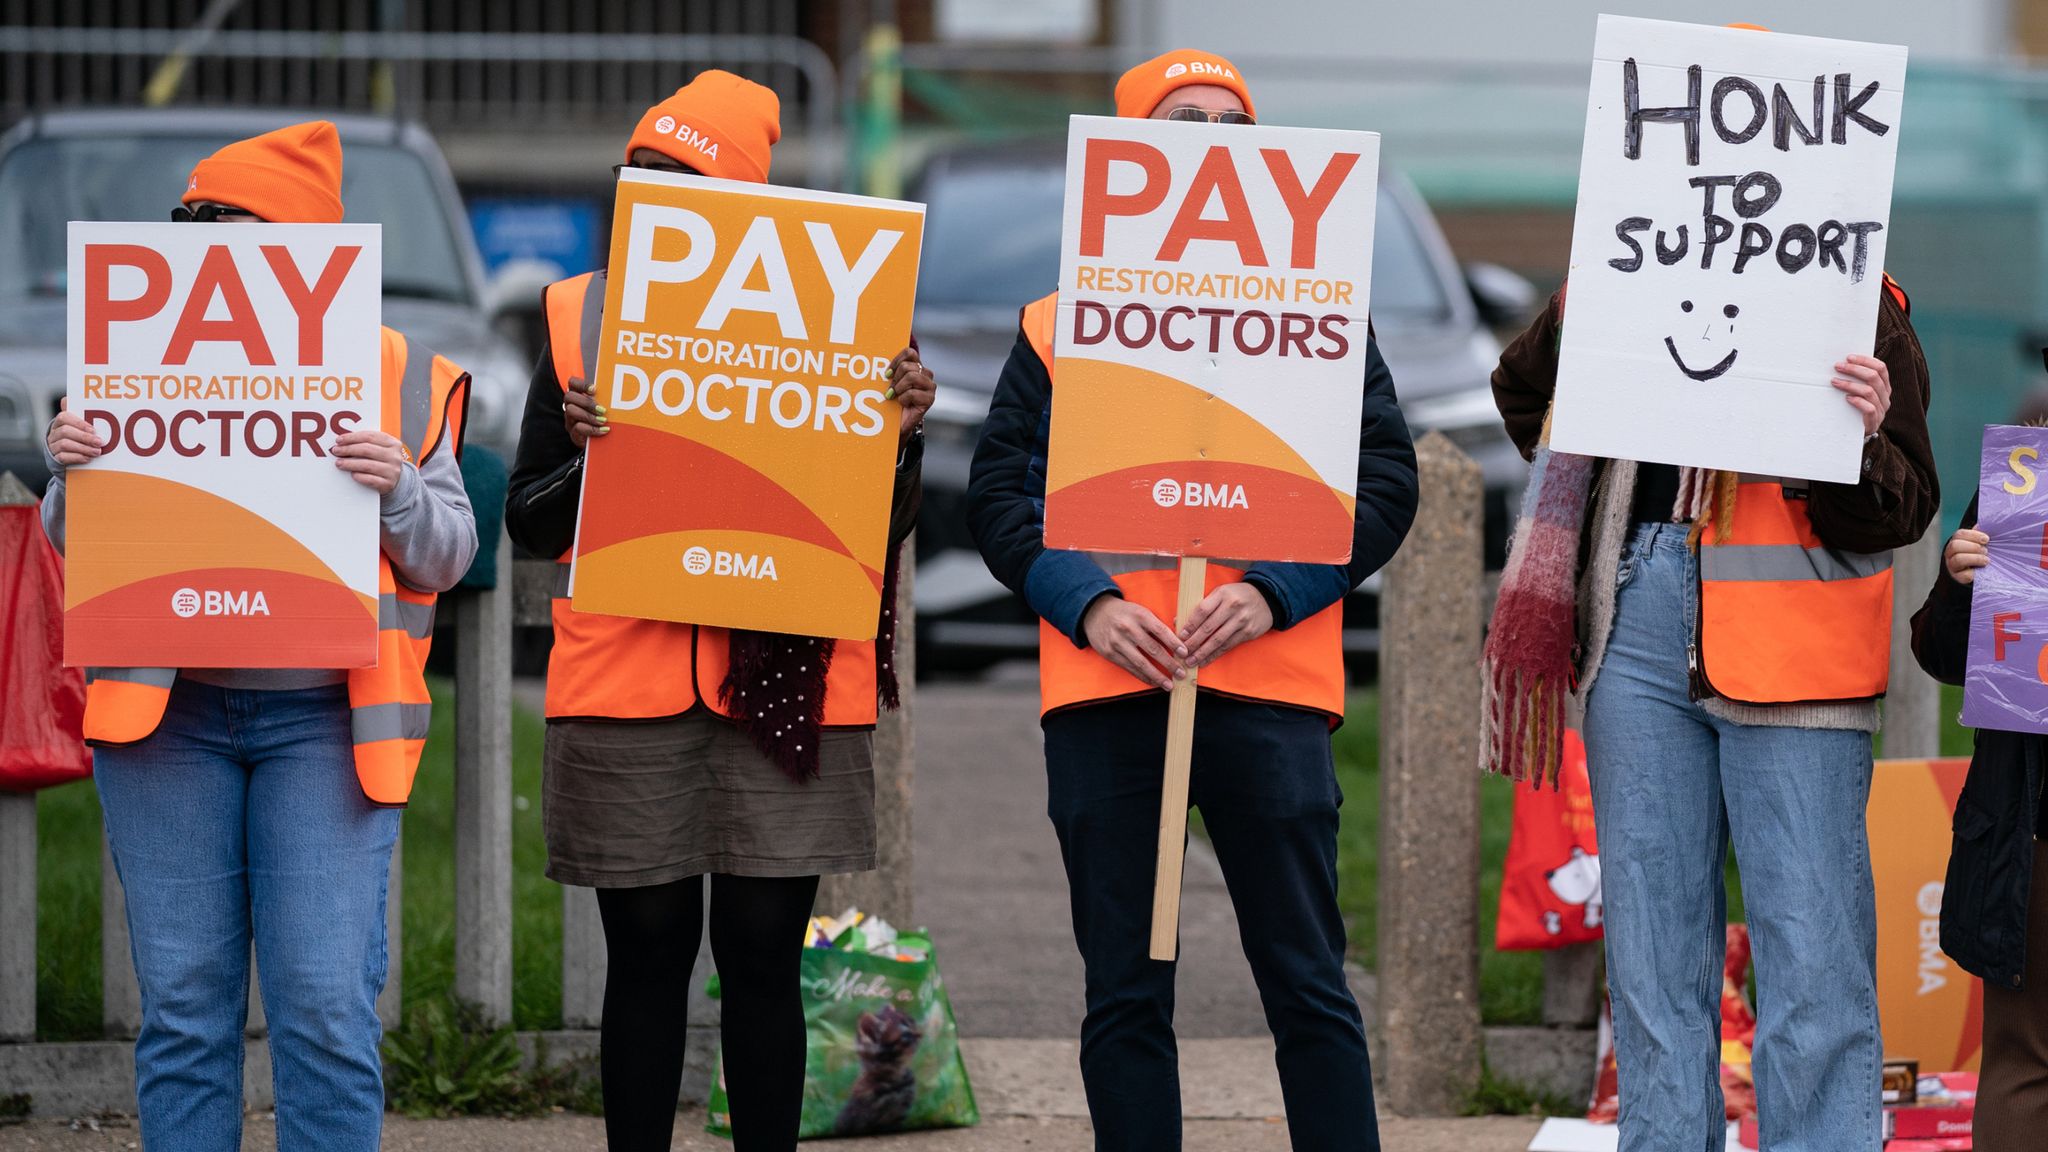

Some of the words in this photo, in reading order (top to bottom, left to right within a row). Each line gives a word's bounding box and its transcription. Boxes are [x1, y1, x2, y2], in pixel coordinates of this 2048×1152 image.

[1189, 61, 1235, 81] BMA
[1623, 57, 1890, 166] HONK
[675, 124, 719, 161] BMA
[1079, 138, 1361, 270] PAY
[1689, 170, 1782, 220] TO
[620, 203, 904, 345] PAY
[1608, 212, 1884, 285] SUPPORT
[84, 244, 363, 367] PAY
[1076, 266, 1285, 301] RESTORATION
[1294, 278, 1353, 305] FOR
[1073, 300, 1350, 360] DOCTORS
[616, 330, 824, 375] RESTORATION
[832, 352, 890, 382] FOR
[84, 375, 294, 400] RESTORATION
[304, 376, 363, 401] FOR
[610, 364, 887, 437] DOCTORS
[1184, 483, 1249, 510] BMA
[713, 552, 778, 581] BMA
[204, 591, 270, 616] BMA
[1917, 918, 1948, 997] BMA
[812, 966, 893, 1001] Make
